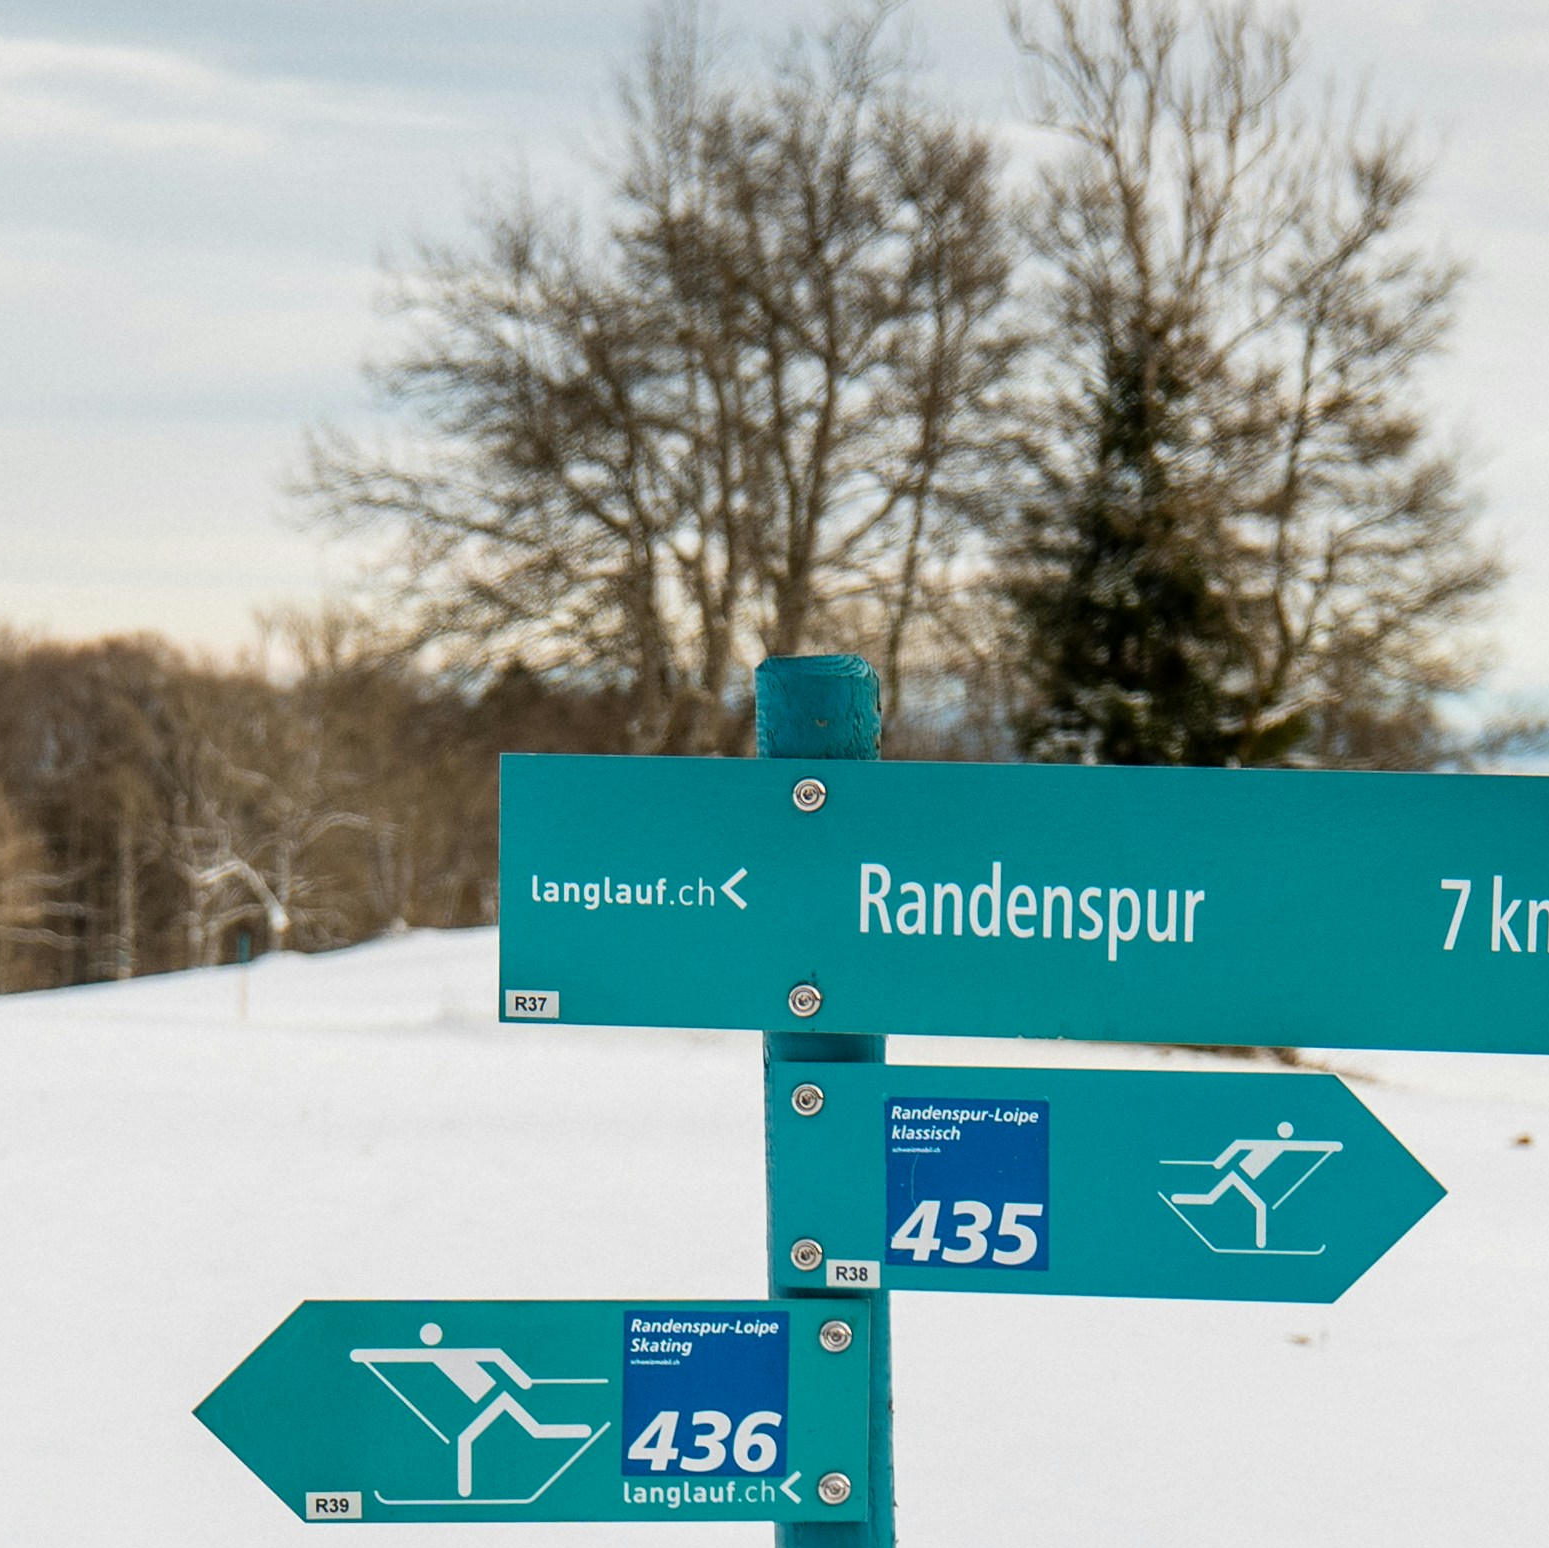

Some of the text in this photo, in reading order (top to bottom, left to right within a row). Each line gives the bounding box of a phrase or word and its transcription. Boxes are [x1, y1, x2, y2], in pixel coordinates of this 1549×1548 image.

[531, 874, 715, 910] langlauf.ch
[858, 860, 1205, 962] Randenspur
[1440, 878, 1472, 951] 7
[514, 995, 548, 1013] R37
[890, 1105, 1039, 1126] Randenspur-Loipe
[891, 1125, 961, 1141] klassisch
[890, 1199, 1044, 1266] 435
[835, 1266, 869, 1282] R38
[630, 1318, 779, 1337] Randenspur-Loipe
[630, 1337, 693, 1357] Skating
[627, 1410, 783, 1473] 436
[623, 1480, 776, 1509] langlauf.ch
[315, 1498, 350, 1513] R39
